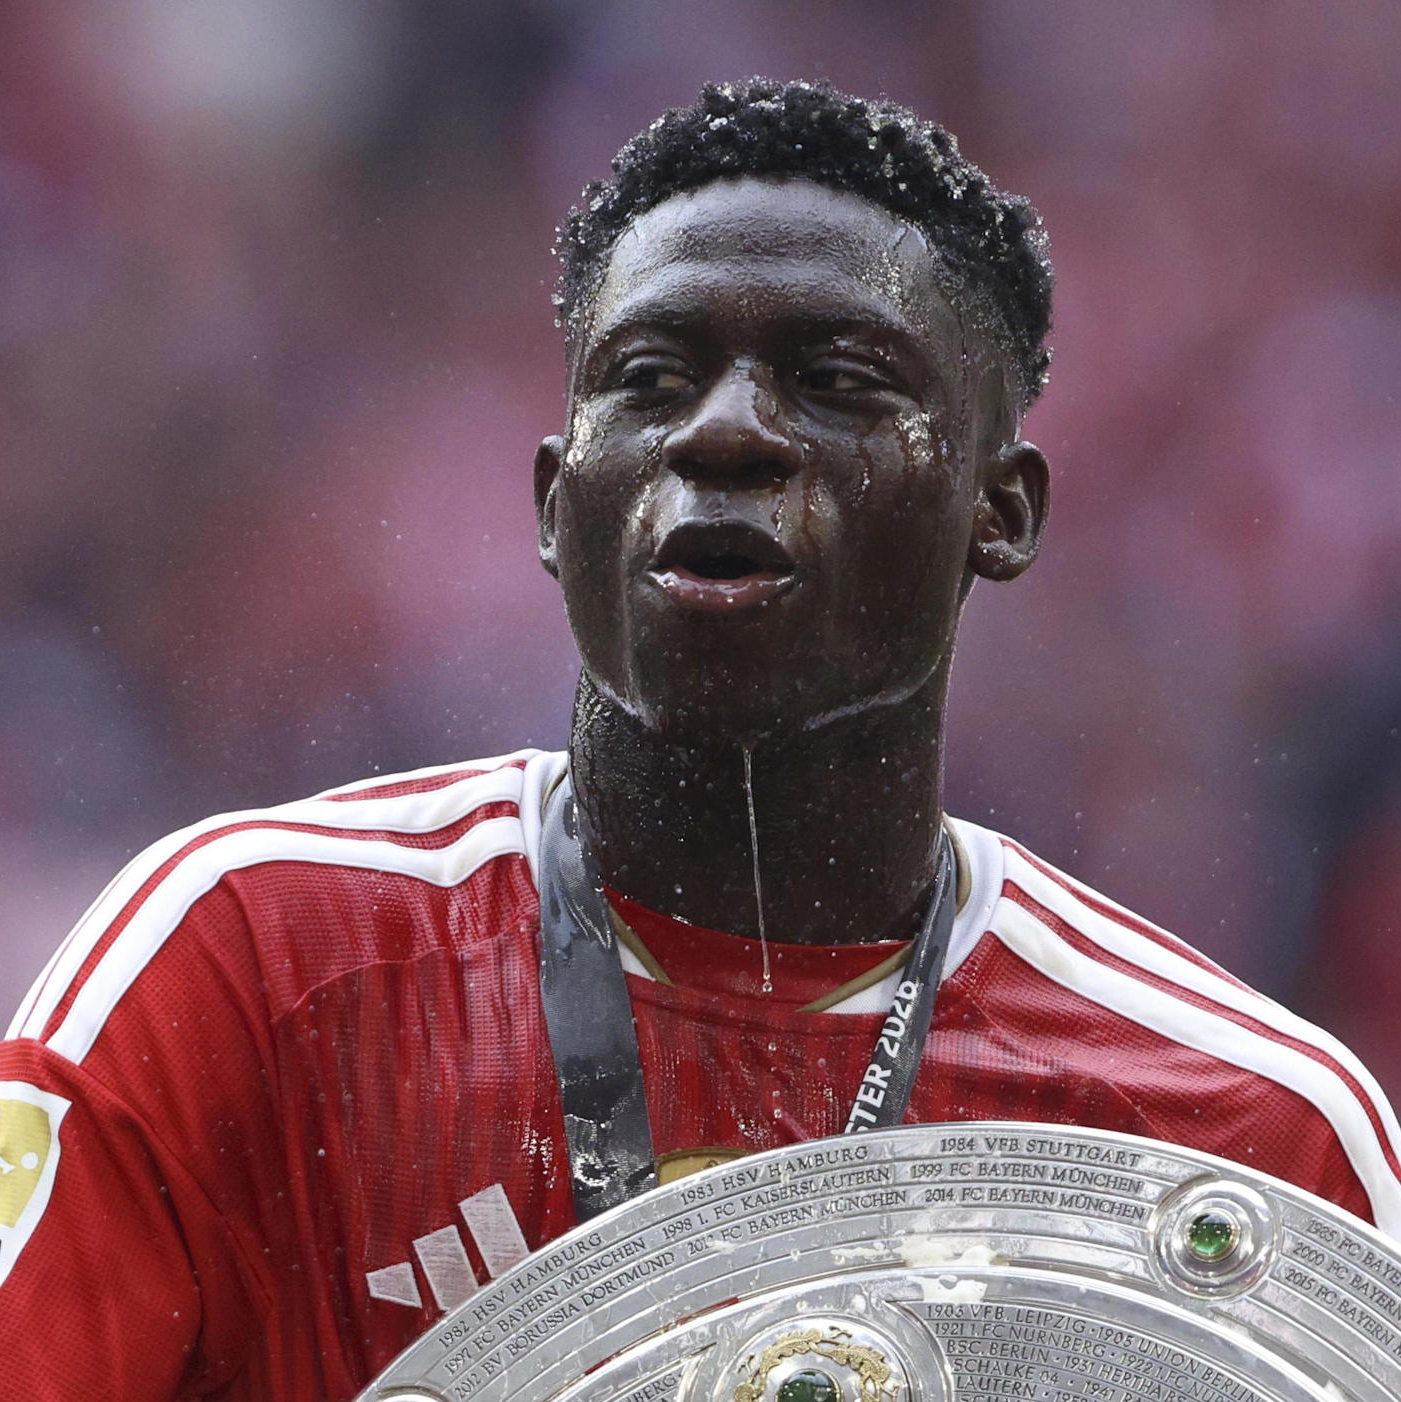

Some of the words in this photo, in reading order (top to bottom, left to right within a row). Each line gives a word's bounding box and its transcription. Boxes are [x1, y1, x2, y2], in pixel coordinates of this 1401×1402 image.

[874, 980, 919, 1058] 2026
[680, 1183, 714, 1205] 1983
[722, 1168, 760, 1191] HSV
[767, 1146, 867, 1178] HAMBURG
[912, 1163, 941, 1177] 1999
[949, 1163, 971, 1175] FC
[978, 1163, 1045, 1178] BAYERN
[1051, 1164, 1142, 1193] MÜNCHEN
[940, 1138, 974, 1151] 1984
[983, 1138, 1018, 1151] VFB
[1024, 1139, 1140, 1168] STUTTGART
[661, 1217, 693, 1239] 1998
[713, 1201, 735, 1219] FC
[741, 1167, 889, 1210] KAISERSLAUTERN
[721, 1224, 742, 1241] FC
[747, 1205, 813, 1233] BAYERN
[820, 1191, 905, 1215] MÜNCHEN
[924, 1188, 953, 1201] 2014
[962, 1188, 982, 1200] FC
[988, 1188, 1053, 1204] BAYERN
[1059, 1191, 1145, 1220] MÜNCHEN
[1291, 1242, 1325, 1267] 2000
[1325, 1260, 1349, 1281] FC
[1337, 1236, 1362, 1258] FC
[437, 1319, 469, 1348] 1982
[472, 1290, 508, 1321] HSV
[510, 1232, 602, 1294] HAMBURG
[443, 1347, 473, 1375] 1997
[472, 1328, 496, 1351] FC
[496, 1285, 559, 1333] BAYERN
[561, 1237, 646, 1290] MÜNCHEN
[1284, 1267, 1314, 1291] 2015
[1314, 1284, 1338, 1305] FC
[1337, 1299, 1395, 1346] BAYERN
[453, 1372, 481, 1398] 2012
[481, 1352, 505, 1375] BV
[505, 1300, 580, 1356] BORUSSIA
[581, 1250, 676, 1306] DORTMUND
[1015, 1308, 1087, 1333] LEIPZIG
[1095, 1325, 1134, 1348] 1905
[1137, 1338, 1200, 1374] UNION
